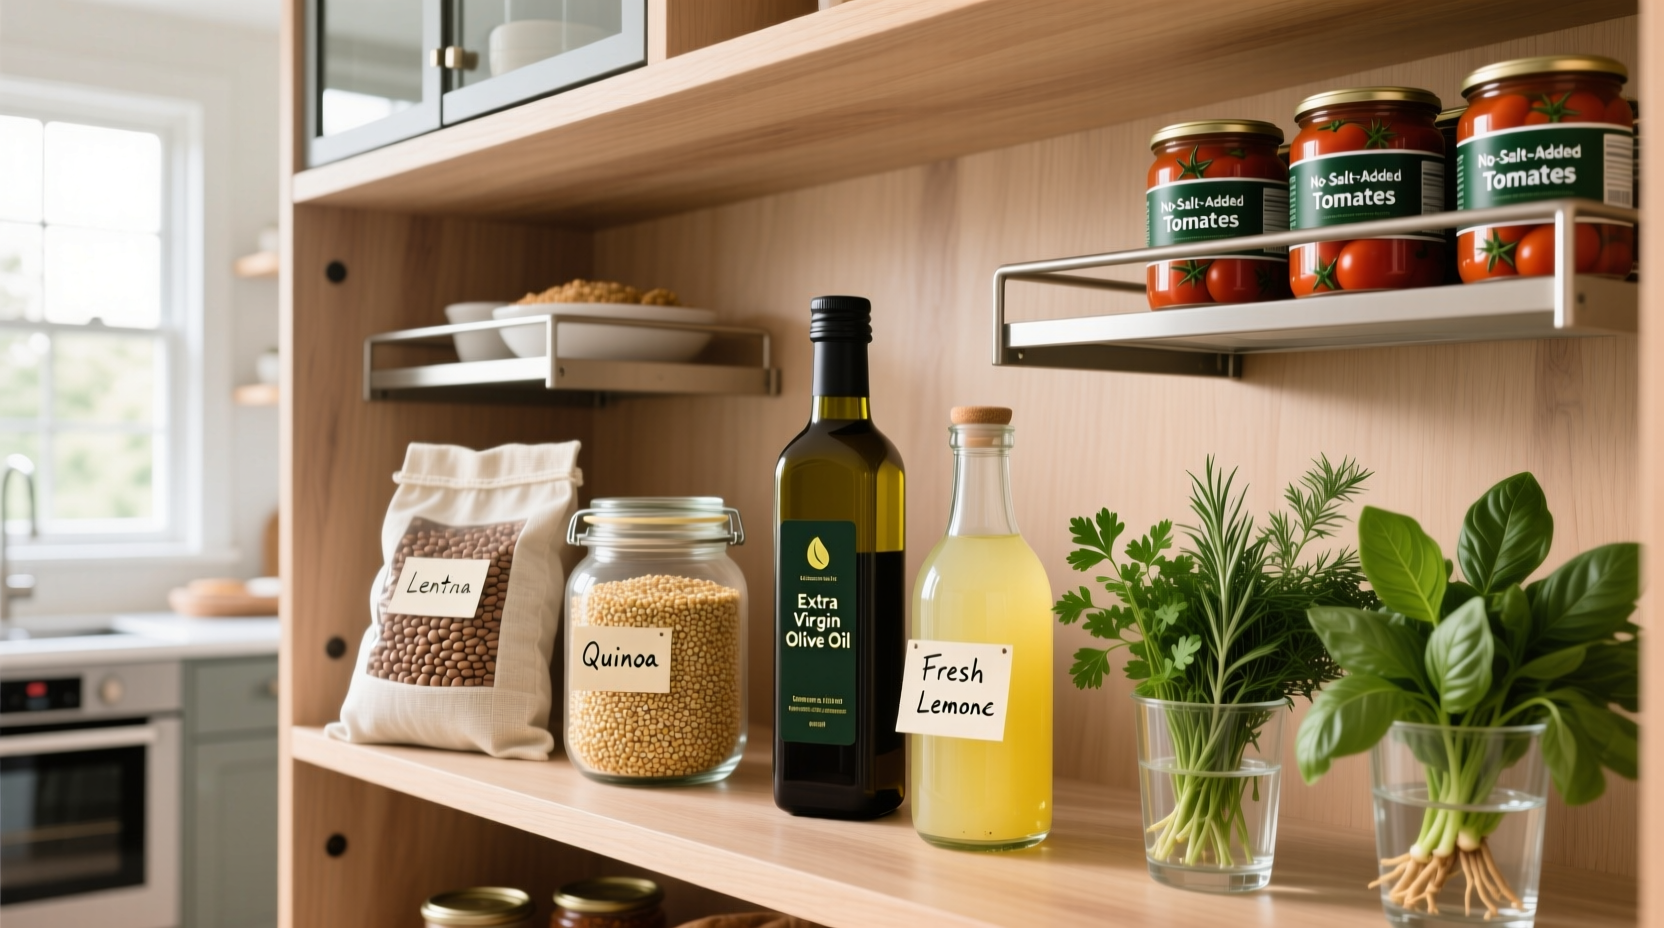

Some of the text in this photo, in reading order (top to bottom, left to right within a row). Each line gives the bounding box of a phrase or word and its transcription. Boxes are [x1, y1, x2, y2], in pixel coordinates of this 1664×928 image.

[1477, 143, 1582, 168] No-Salt-Added
[1482, 164, 1577, 191] Tomates
[1312, 187, 1396, 211] Tomates
[1163, 211, 1240, 233] Tomates
[797, 593, 838, 610] Extra
[793, 611, 841, 633] Virgin
[785, 630, 851, 649] Olive Oil
[582, 640, 659, 671] Quinoa
[922, 653, 983, 684] Fresh
